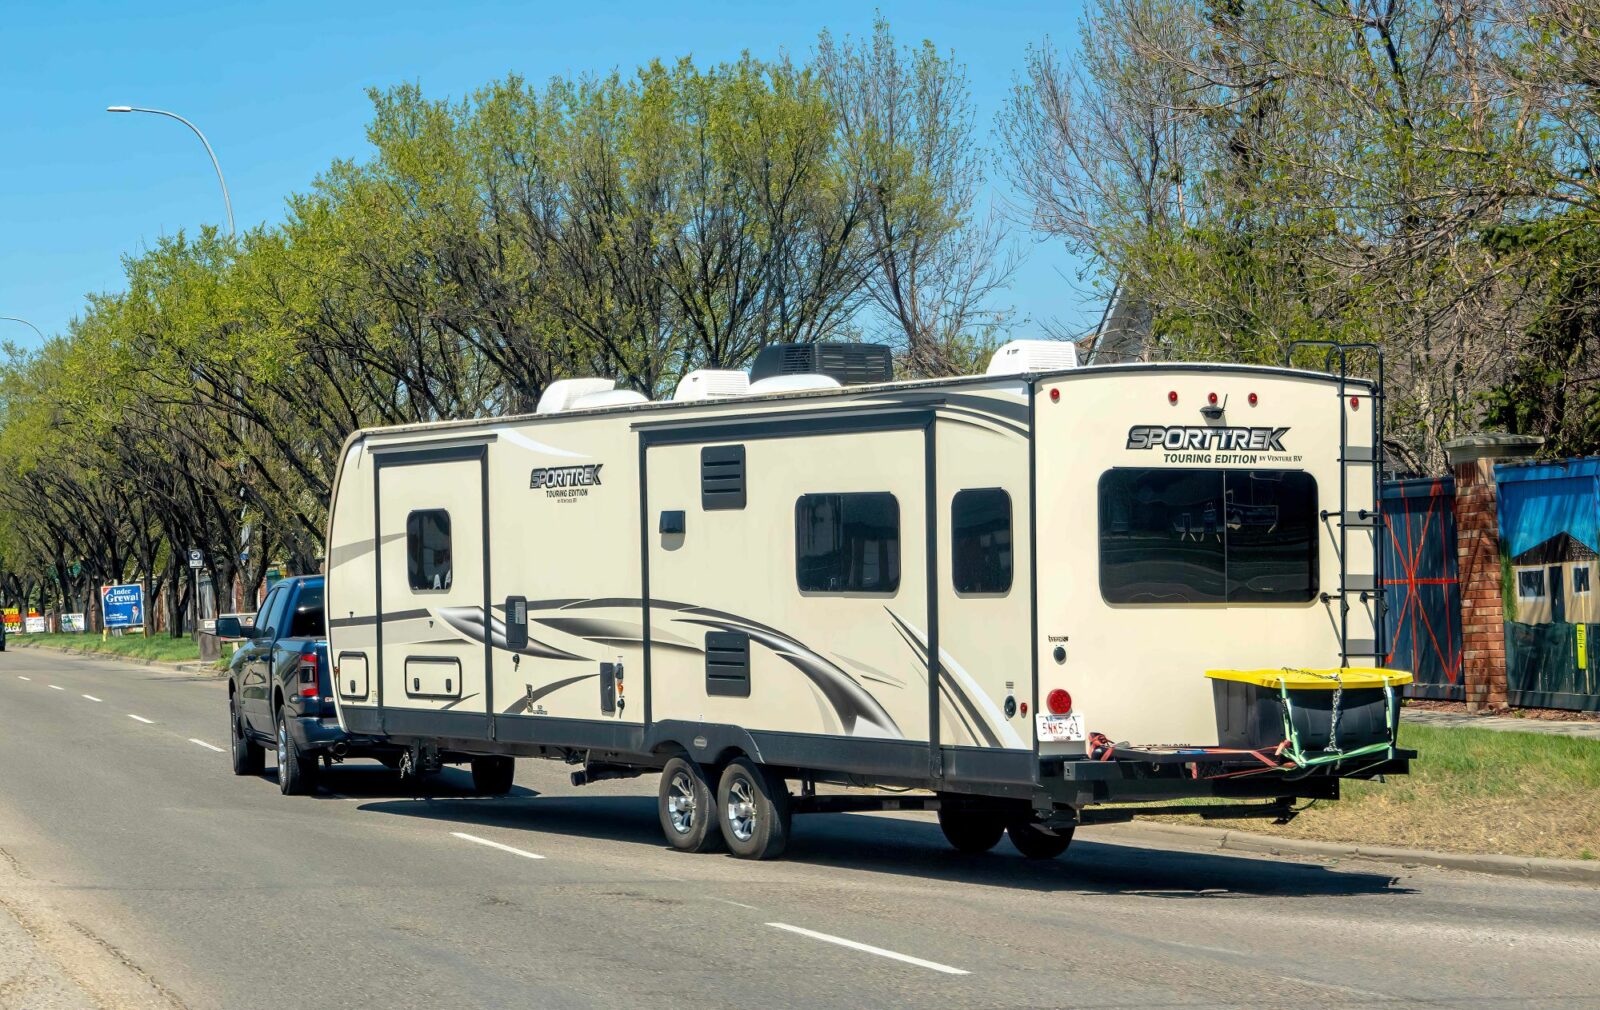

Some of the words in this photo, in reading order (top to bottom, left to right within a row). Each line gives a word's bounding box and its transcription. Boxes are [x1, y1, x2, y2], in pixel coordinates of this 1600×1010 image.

[1126, 425, 1291, 451] SPORTTREK
[1164, 453, 1211, 464] TOURING
[1215, 454, 1257, 464] EDITION
[530, 463, 604, 489] SPORTTREK
[546, 489, 568, 498] TOURING
[568, 488, 588, 497] EDITION
[105, 592, 139, 603] Grewal
